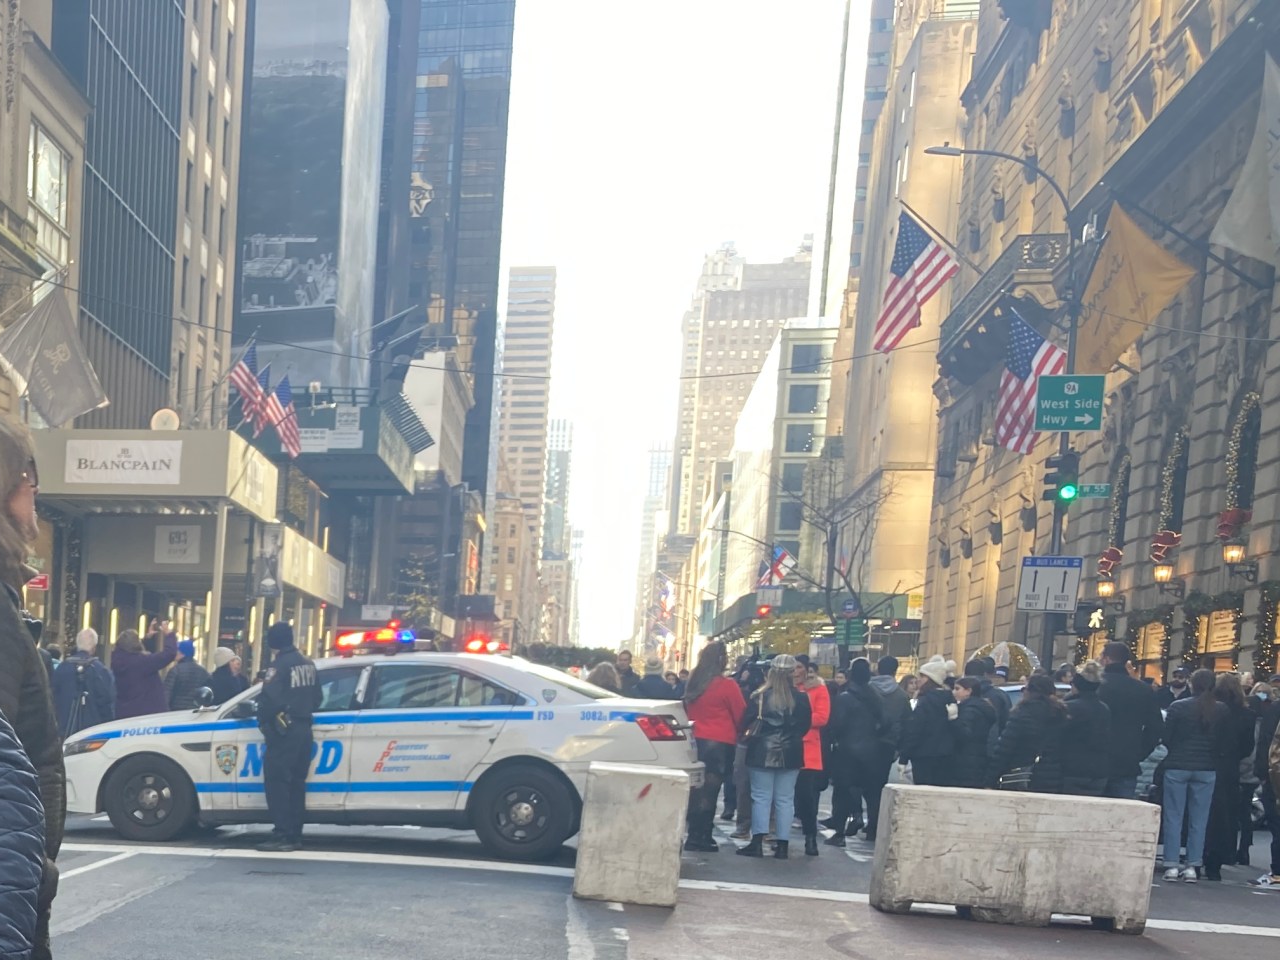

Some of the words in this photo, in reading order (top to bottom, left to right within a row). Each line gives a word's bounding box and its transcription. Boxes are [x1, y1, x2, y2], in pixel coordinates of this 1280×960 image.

[1066, 383, 1077, 392] 9A
[1040, 399, 1069, 409] West
[1074, 399, 1100, 409] Side
[1042, 415, 1067, 426] Hwy
[77, 458, 173, 471] BLANCPAIN
[122, 726, 160, 738] POLICE
